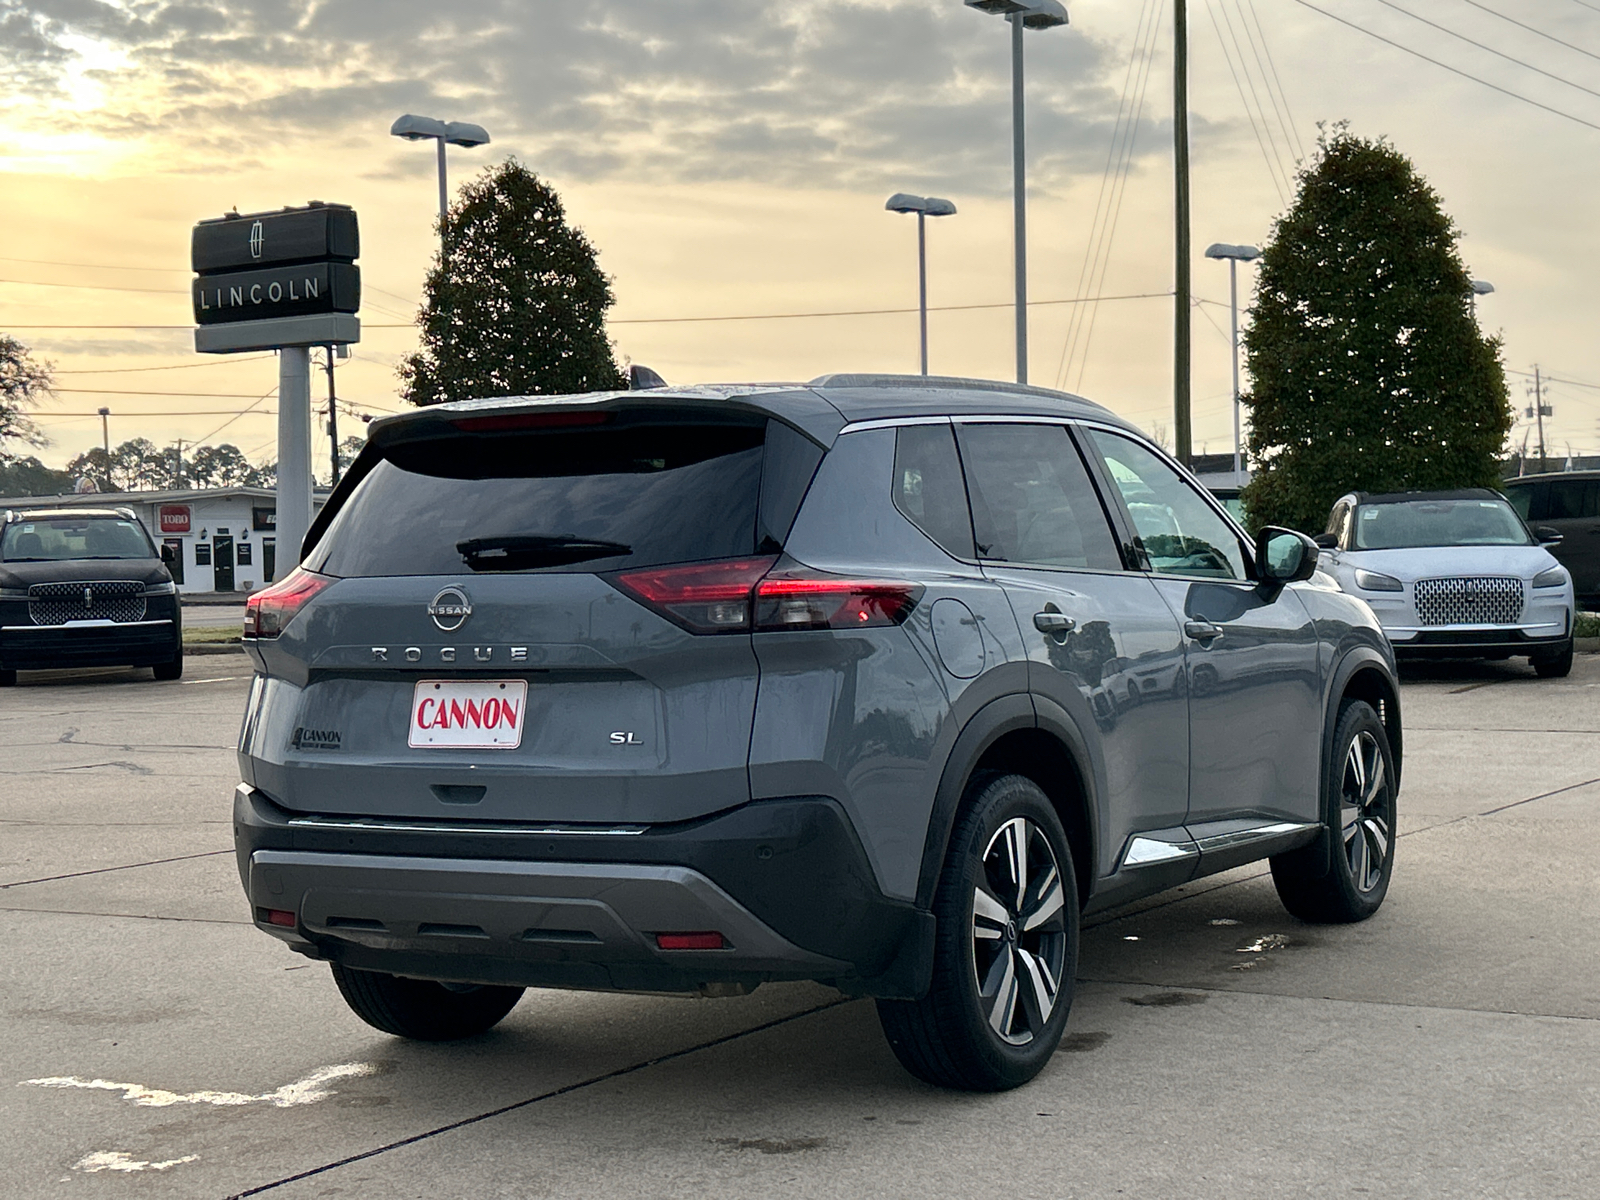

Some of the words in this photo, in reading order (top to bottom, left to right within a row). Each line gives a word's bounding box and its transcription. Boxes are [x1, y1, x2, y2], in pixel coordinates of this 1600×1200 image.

[201, 277, 319, 310] LINCOLN
[162, 514, 188, 524] TORO
[427, 605, 472, 615] NISSAN
[371, 647, 528, 662] ROGUE
[417, 697, 519, 730] CANNON
[303, 729, 342, 742] CANNON
[609, 731, 644, 744] SL
